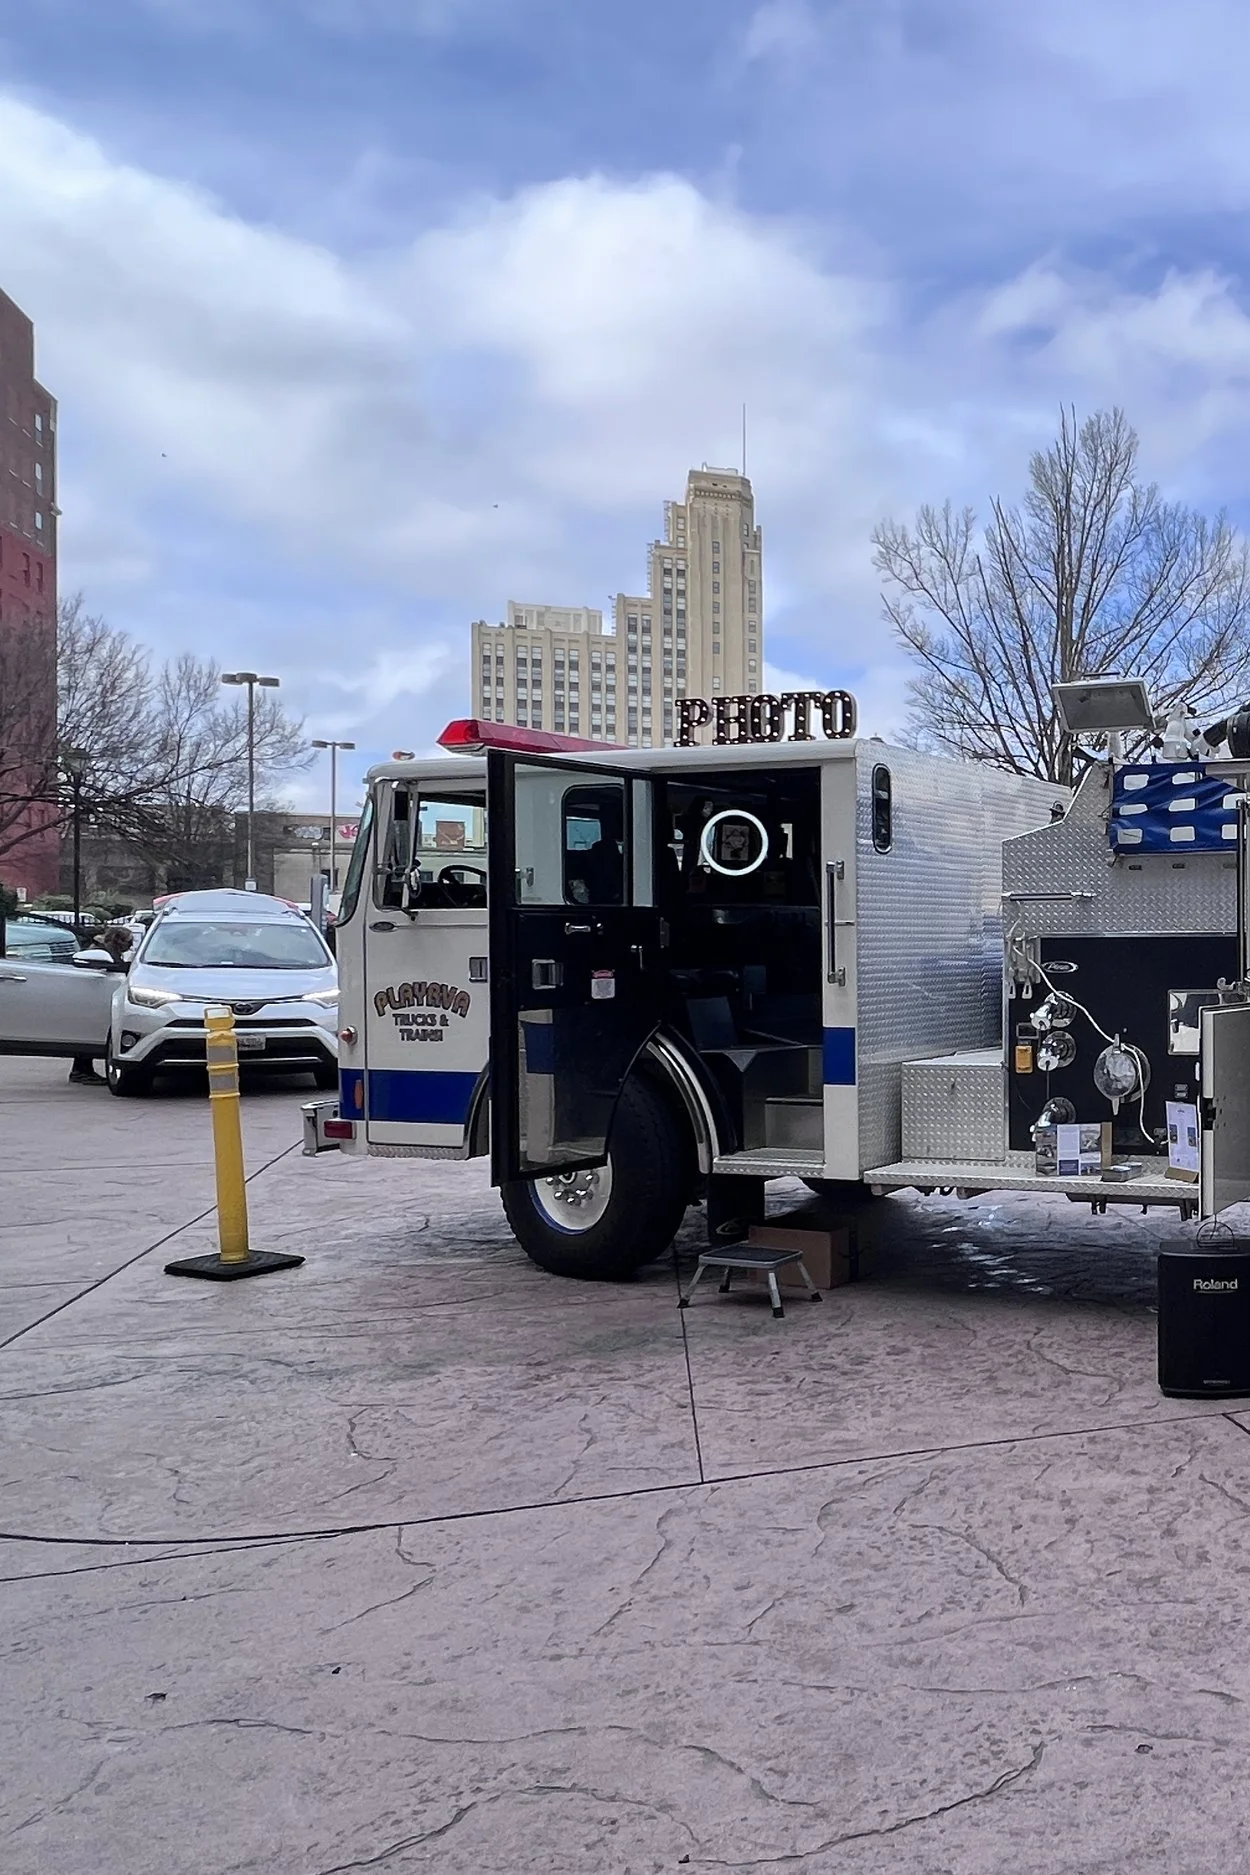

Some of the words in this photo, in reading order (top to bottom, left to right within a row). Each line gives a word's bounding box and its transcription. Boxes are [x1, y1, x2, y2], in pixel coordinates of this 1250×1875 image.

[673, 689, 857, 748] PHOTO
[374, 981, 471, 1018] PLAYRVA
[392, 1013, 437, 1027] TRUCKS
[1193, 1278, 1239, 1290] Roland
